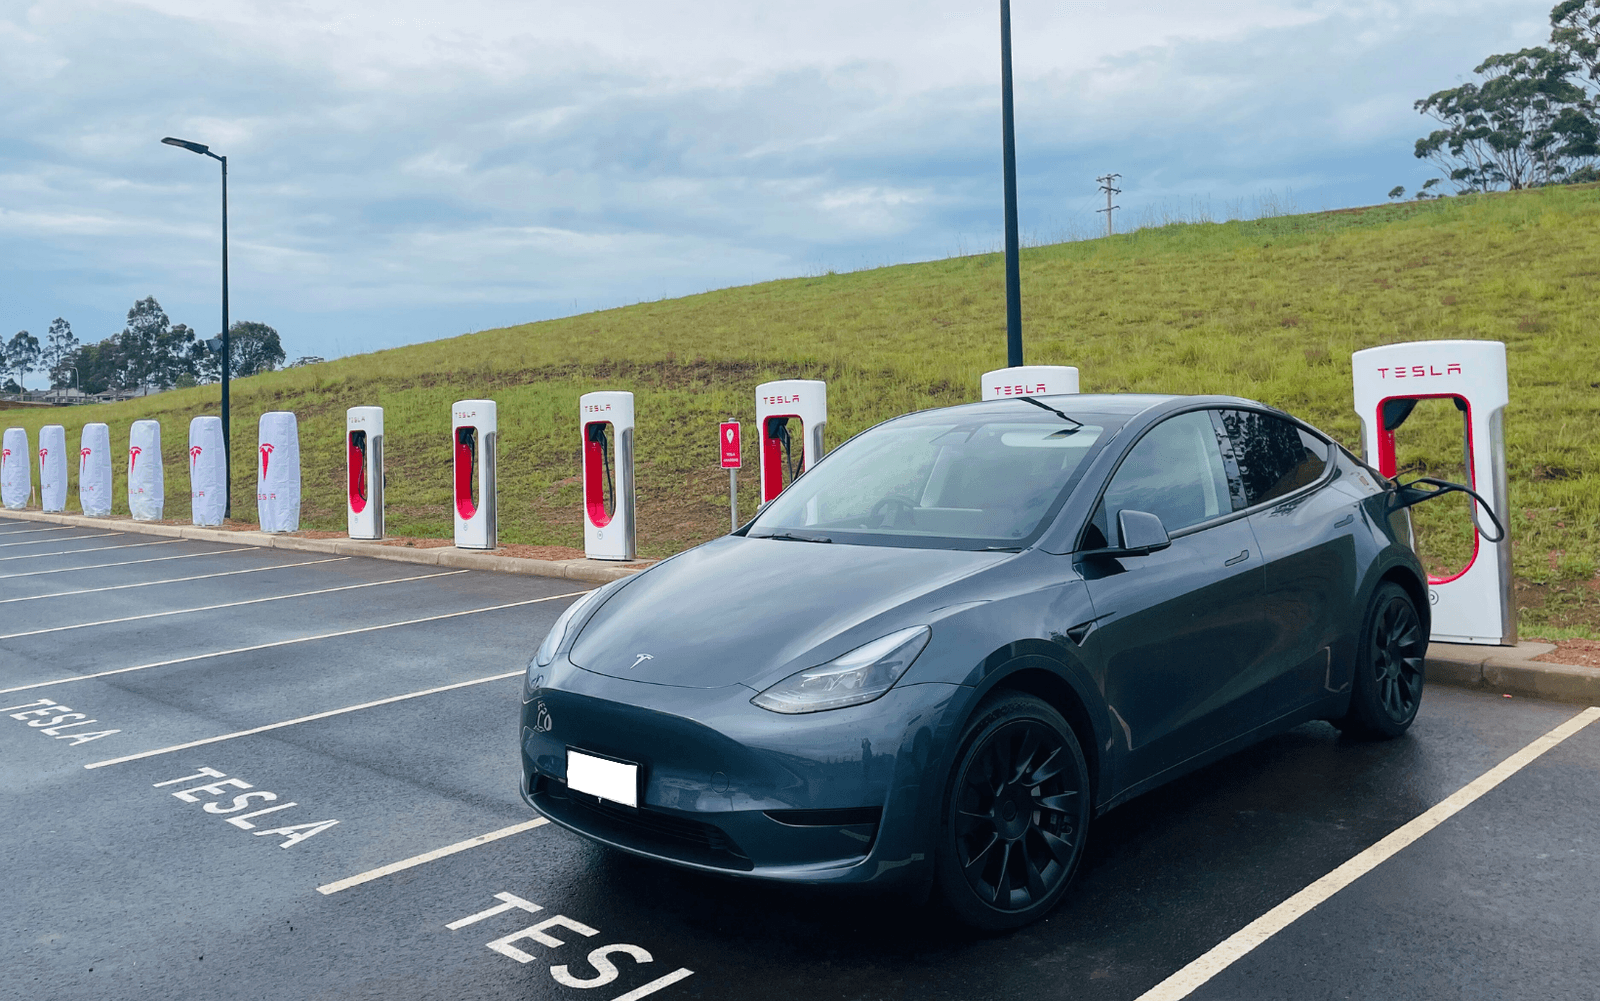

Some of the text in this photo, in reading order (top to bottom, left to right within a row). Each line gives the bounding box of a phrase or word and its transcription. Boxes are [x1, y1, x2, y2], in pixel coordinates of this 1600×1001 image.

[1377, 363, 1461, 379] TESLA
[994, 383, 1046, 395] TESLA
[763, 394, 800, 405] TESLA
[584, 404, 612, 413] TESLA
[455, 411, 476, 419] TESLA
[0, 698, 121, 747] TESLA
[152, 766, 341, 850] TESLA
